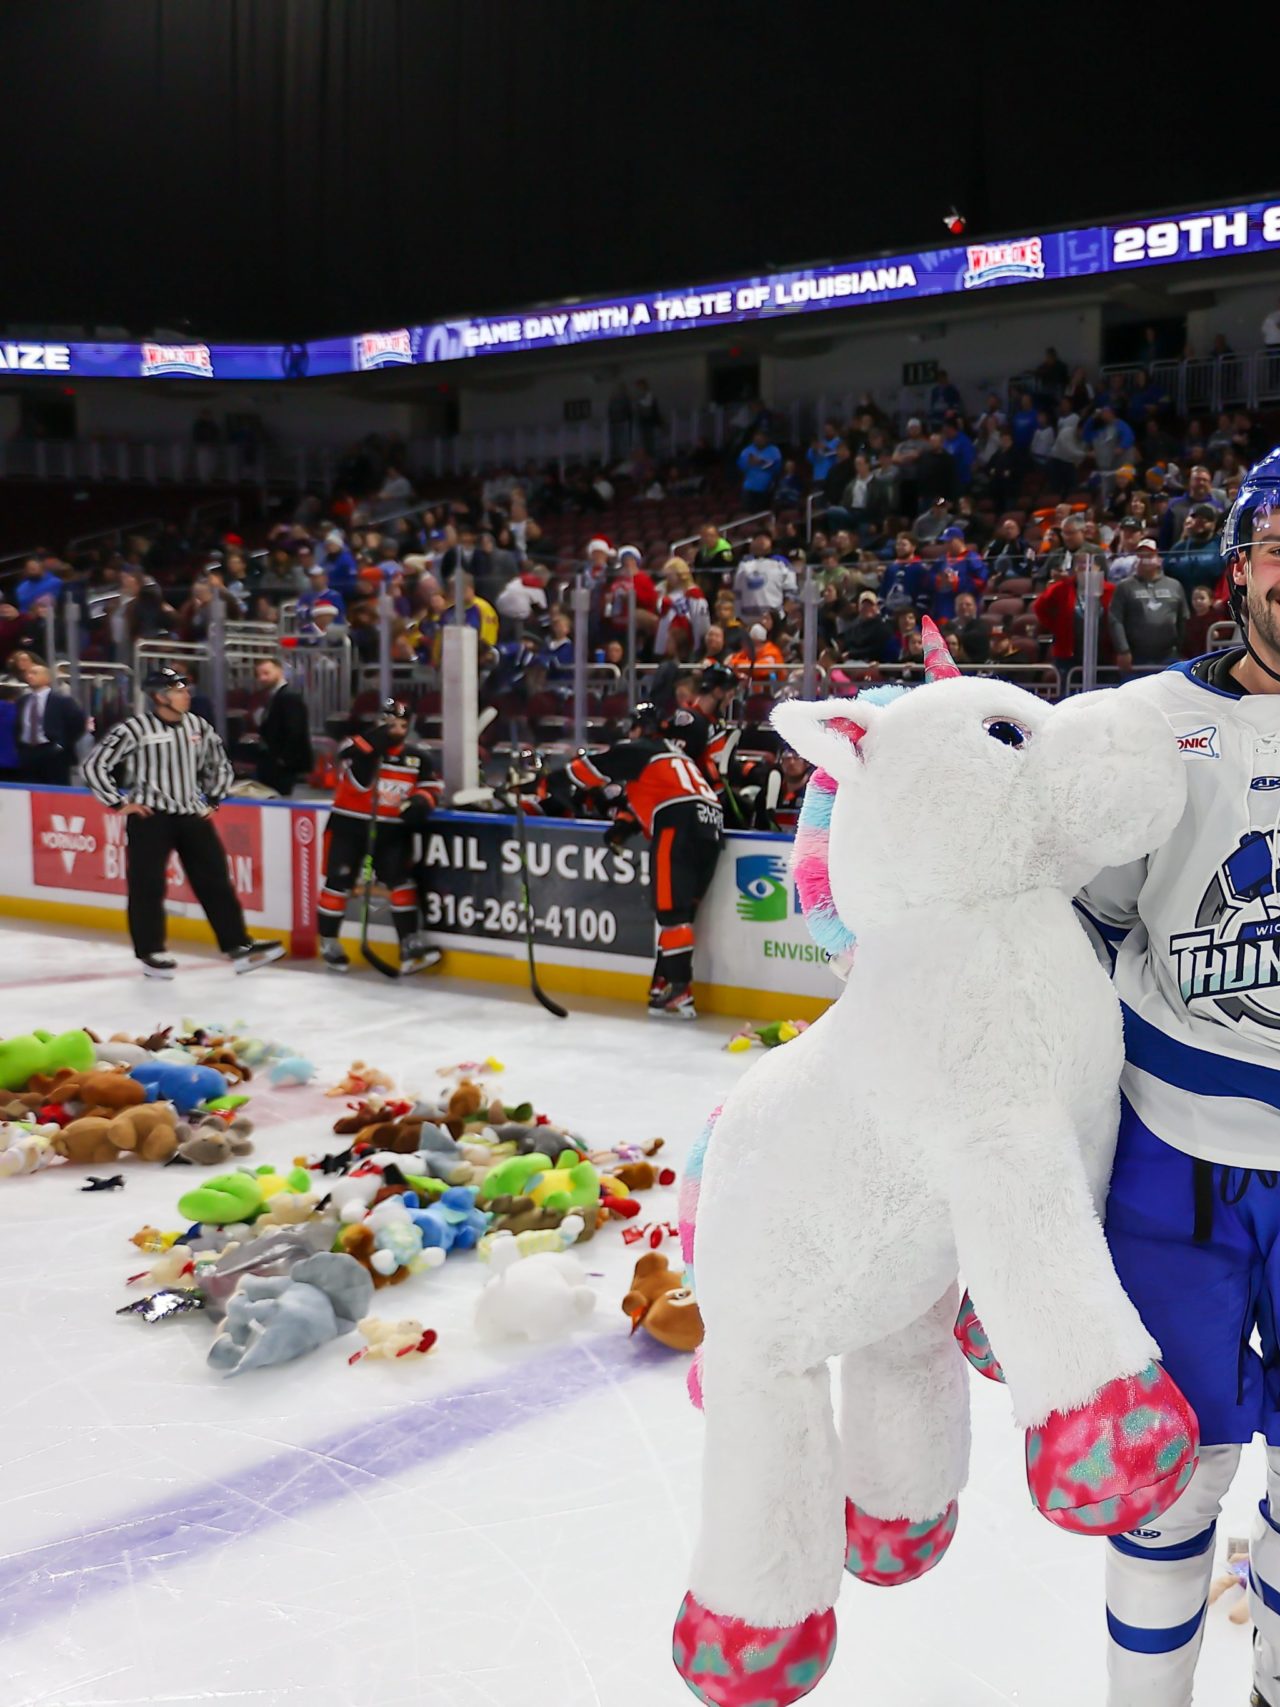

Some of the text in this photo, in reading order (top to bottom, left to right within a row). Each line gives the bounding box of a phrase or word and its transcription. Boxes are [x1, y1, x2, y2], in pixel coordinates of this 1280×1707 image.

[1112, 211, 1248, 263] 29TH
[464, 264, 917, 347] GAME DAY WITH A TASTE OF LOUISIANA
[1176, 736, 1209, 750] ONIC
[412, 832, 651, 887] JAIL SUCKS!
